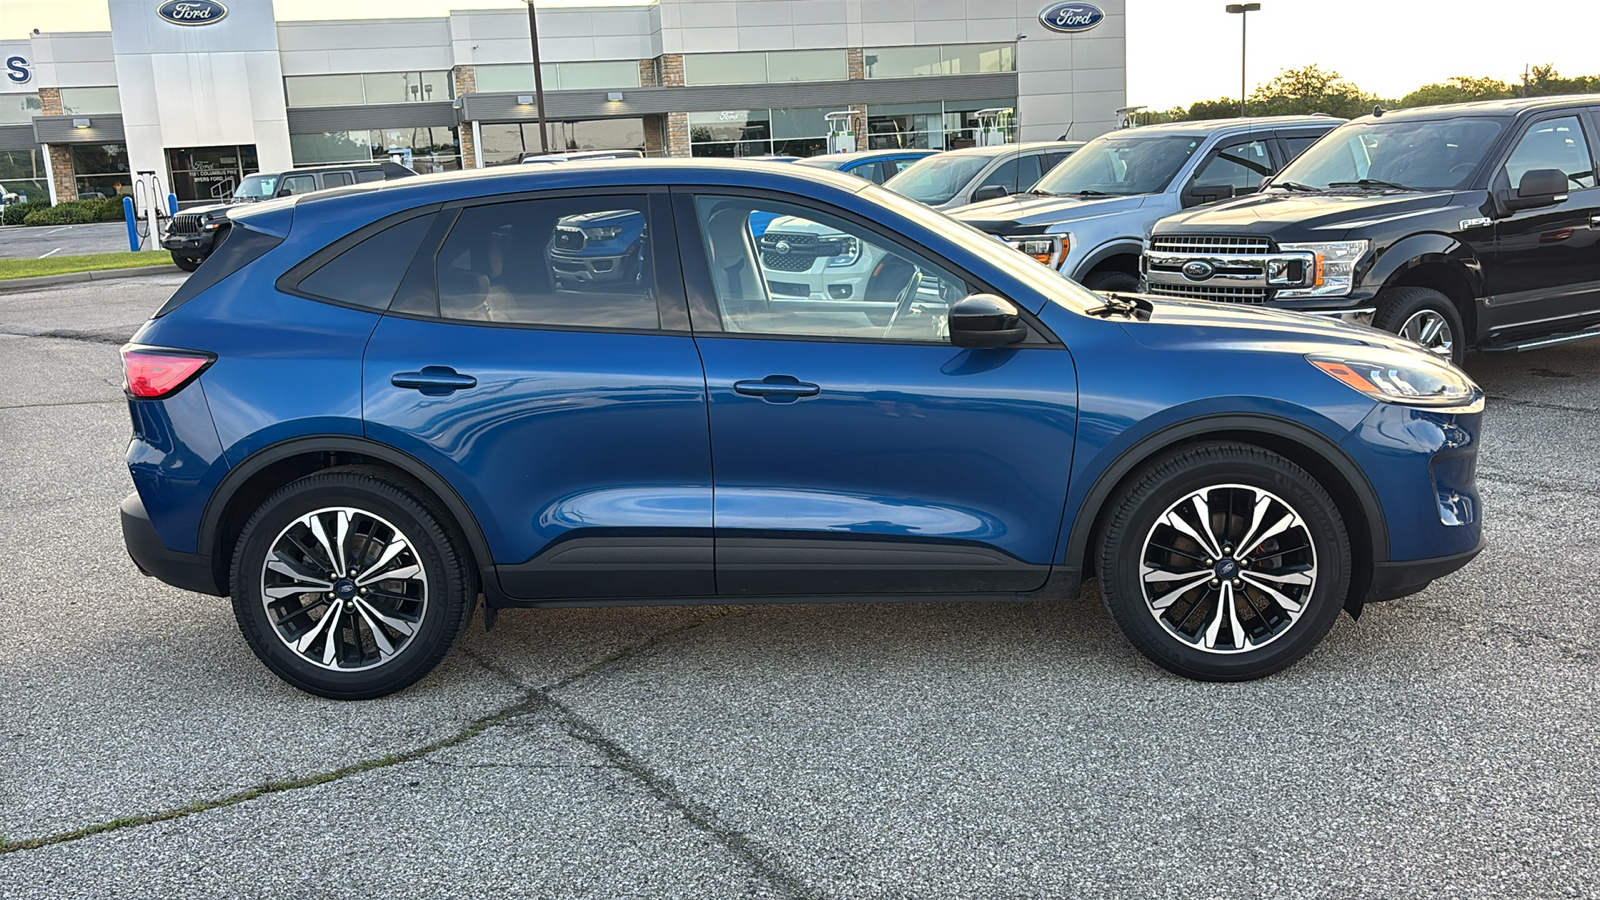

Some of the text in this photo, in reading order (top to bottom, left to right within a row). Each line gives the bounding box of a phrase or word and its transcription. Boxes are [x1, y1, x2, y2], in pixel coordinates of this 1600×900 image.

[172, 3, 212, 19] Ford
[1056, 8, 1092, 25] Ford
[6, 56, 30, 82] S
[719, 111, 739, 121] Ford
[193, 160, 215, 170] Ford
